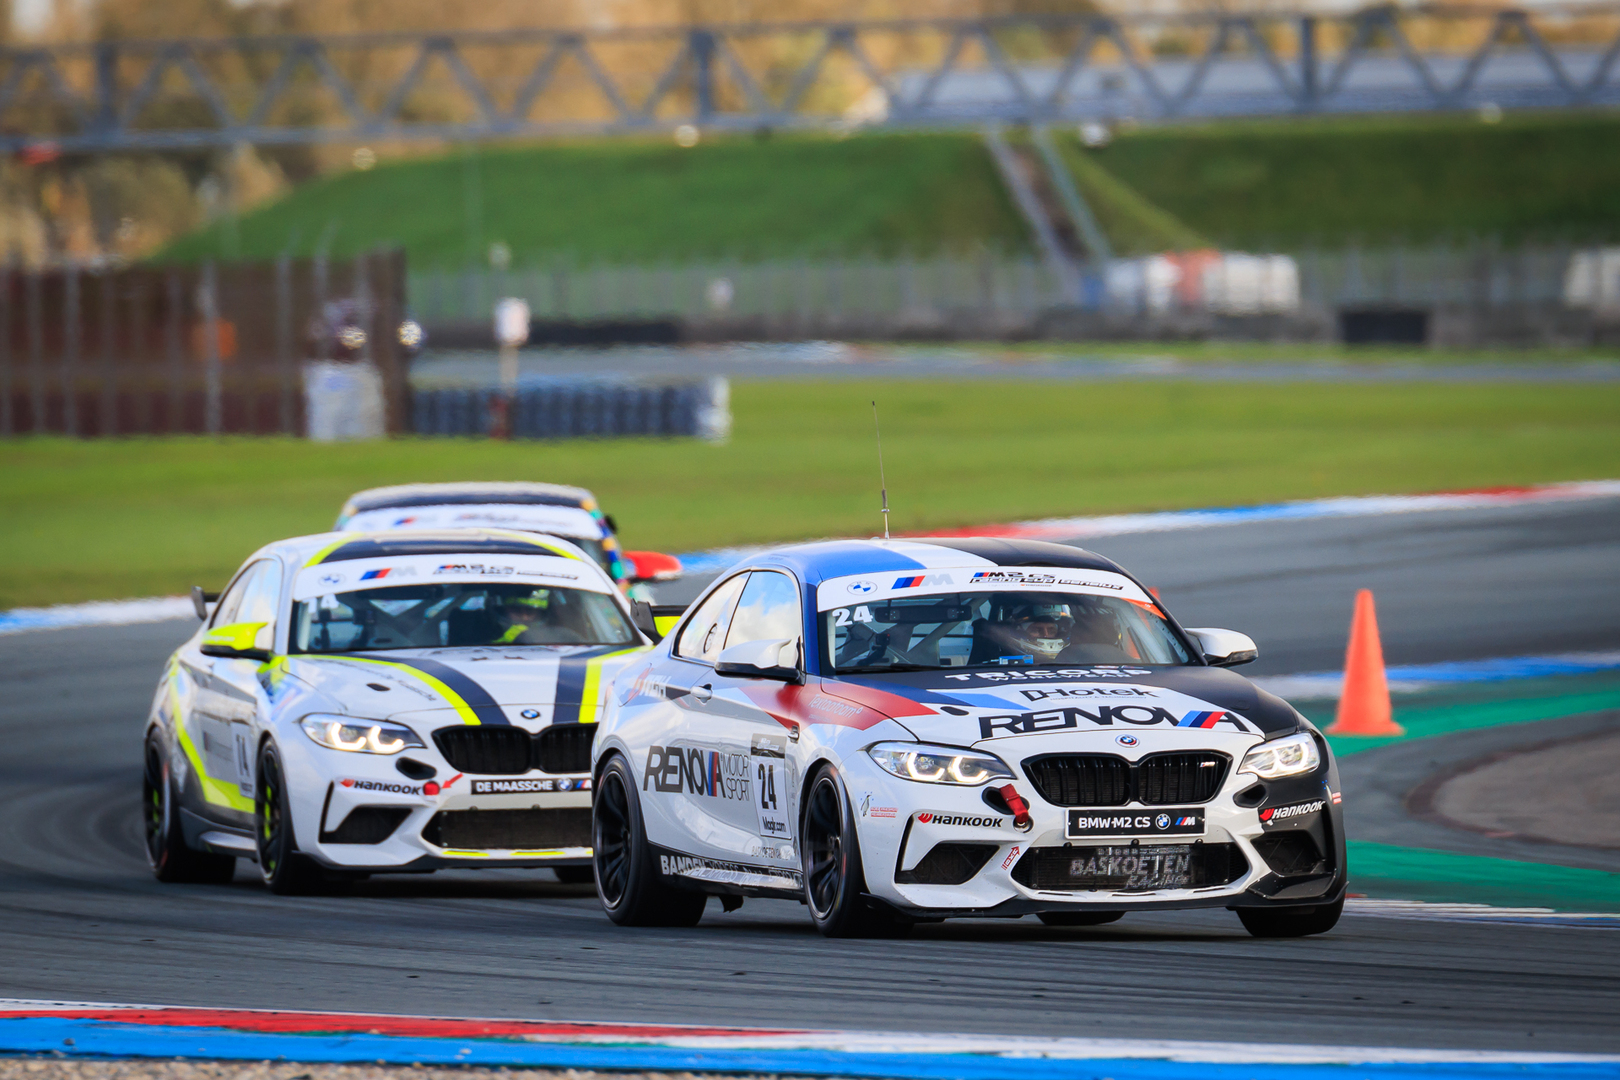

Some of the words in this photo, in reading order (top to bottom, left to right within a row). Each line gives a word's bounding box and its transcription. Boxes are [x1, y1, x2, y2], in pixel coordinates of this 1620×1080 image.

[832, 605, 874, 627] 24
[978, 704, 1251, 739] RENOVA
[643, 745, 726, 798] RENOVA
[722, 752, 750, 777] MOTOR
[476, 782, 492, 792] DE
[493, 780, 553, 791] MAASSCHE
[726, 776, 750, 801] SPORT
[758, 763, 777, 810] 24
[932, 814, 1003, 828] Hankook
[1271, 800, 1326, 819] Hankook
[1078, 817, 1112, 829] BMW
[1113, 816, 1132, 828] M2
[1134, 816, 1151, 828] CS
